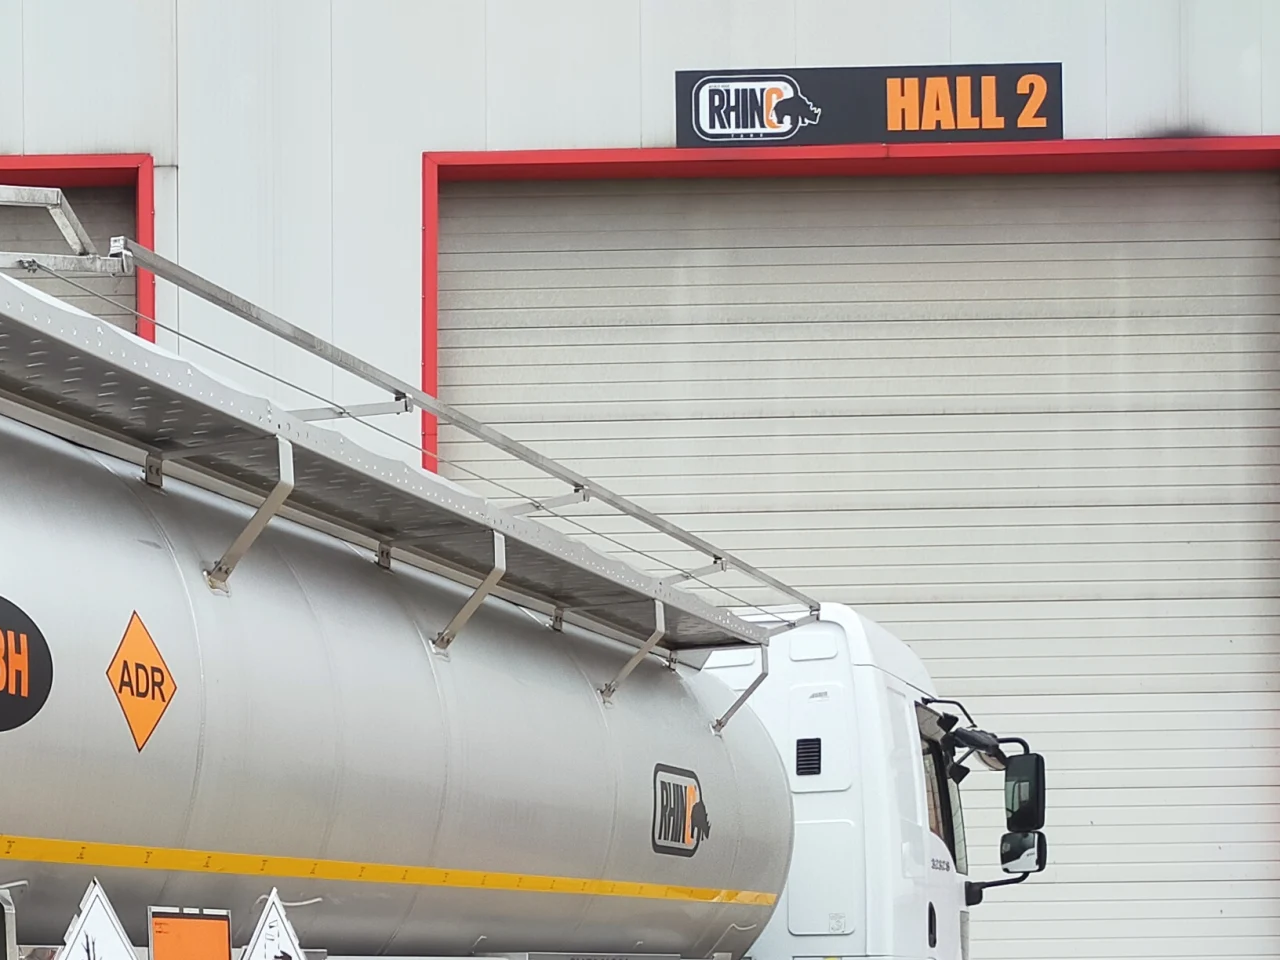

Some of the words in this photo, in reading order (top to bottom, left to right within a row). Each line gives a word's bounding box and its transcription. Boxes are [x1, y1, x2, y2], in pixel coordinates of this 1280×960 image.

[886, 75, 1005, 131] HALL
[1016, 73, 1048, 129] 2
[118, 660, 167, 703] ADR
